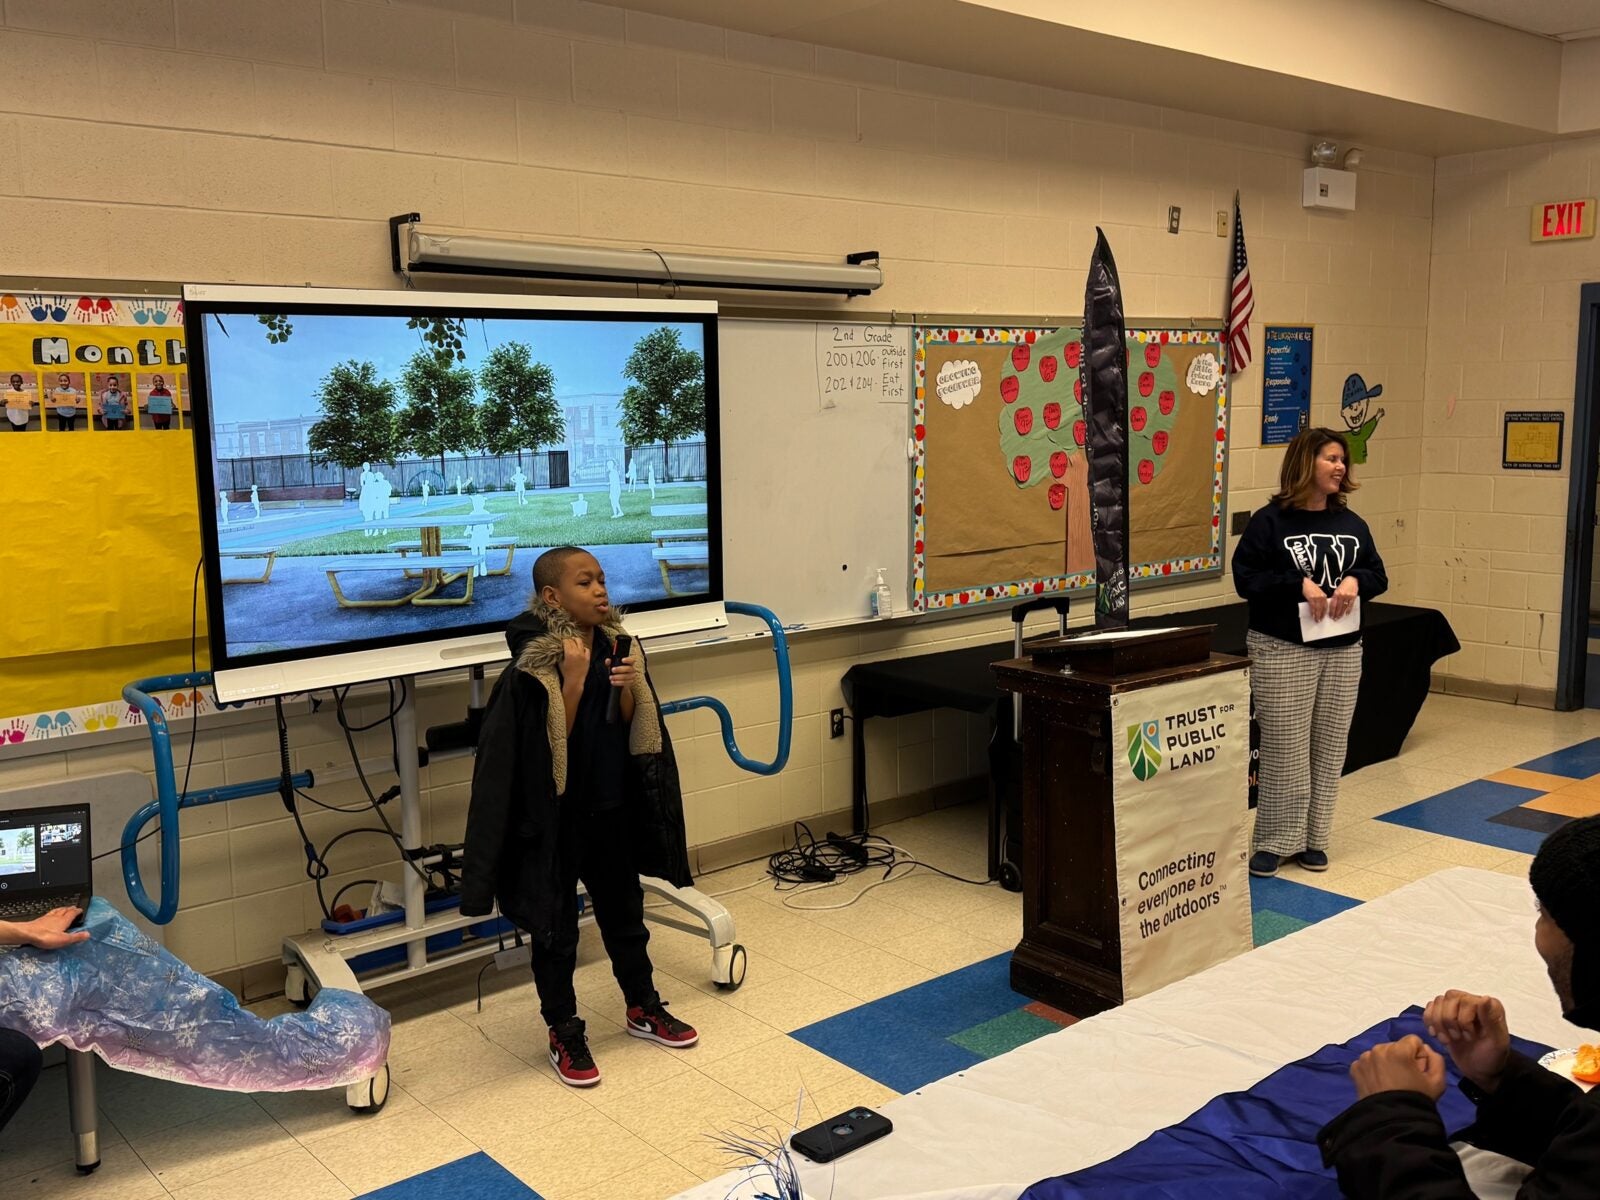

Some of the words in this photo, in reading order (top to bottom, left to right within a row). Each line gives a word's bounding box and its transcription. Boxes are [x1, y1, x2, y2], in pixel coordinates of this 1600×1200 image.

[1542, 201, 1586, 237] EXIT
[832, 326, 854, 342] 2nd
[863, 325, 893, 343] Grade
[826, 351, 848, 367] 200
[856, 349, 876, 367] 206
[881, 346, 907, 357] outside
[825, 376, 848, 394] 202
[856, 376, 873, 392] 204
[882, 372, 900, 385] Eat
[882, 383, 905, 397] First
[1165, 705, 1217, 731] TRUST
[1219, 703, 1235, 714] FOR
[1166, 723, 1226, 751] PUBLIC
[1138, 850, 1216, 891] Connecting
[1137, 880, 1196, 914] everyone
[1200, 871, 1214, 889] to
[1139, 917, 1161, 939] the
